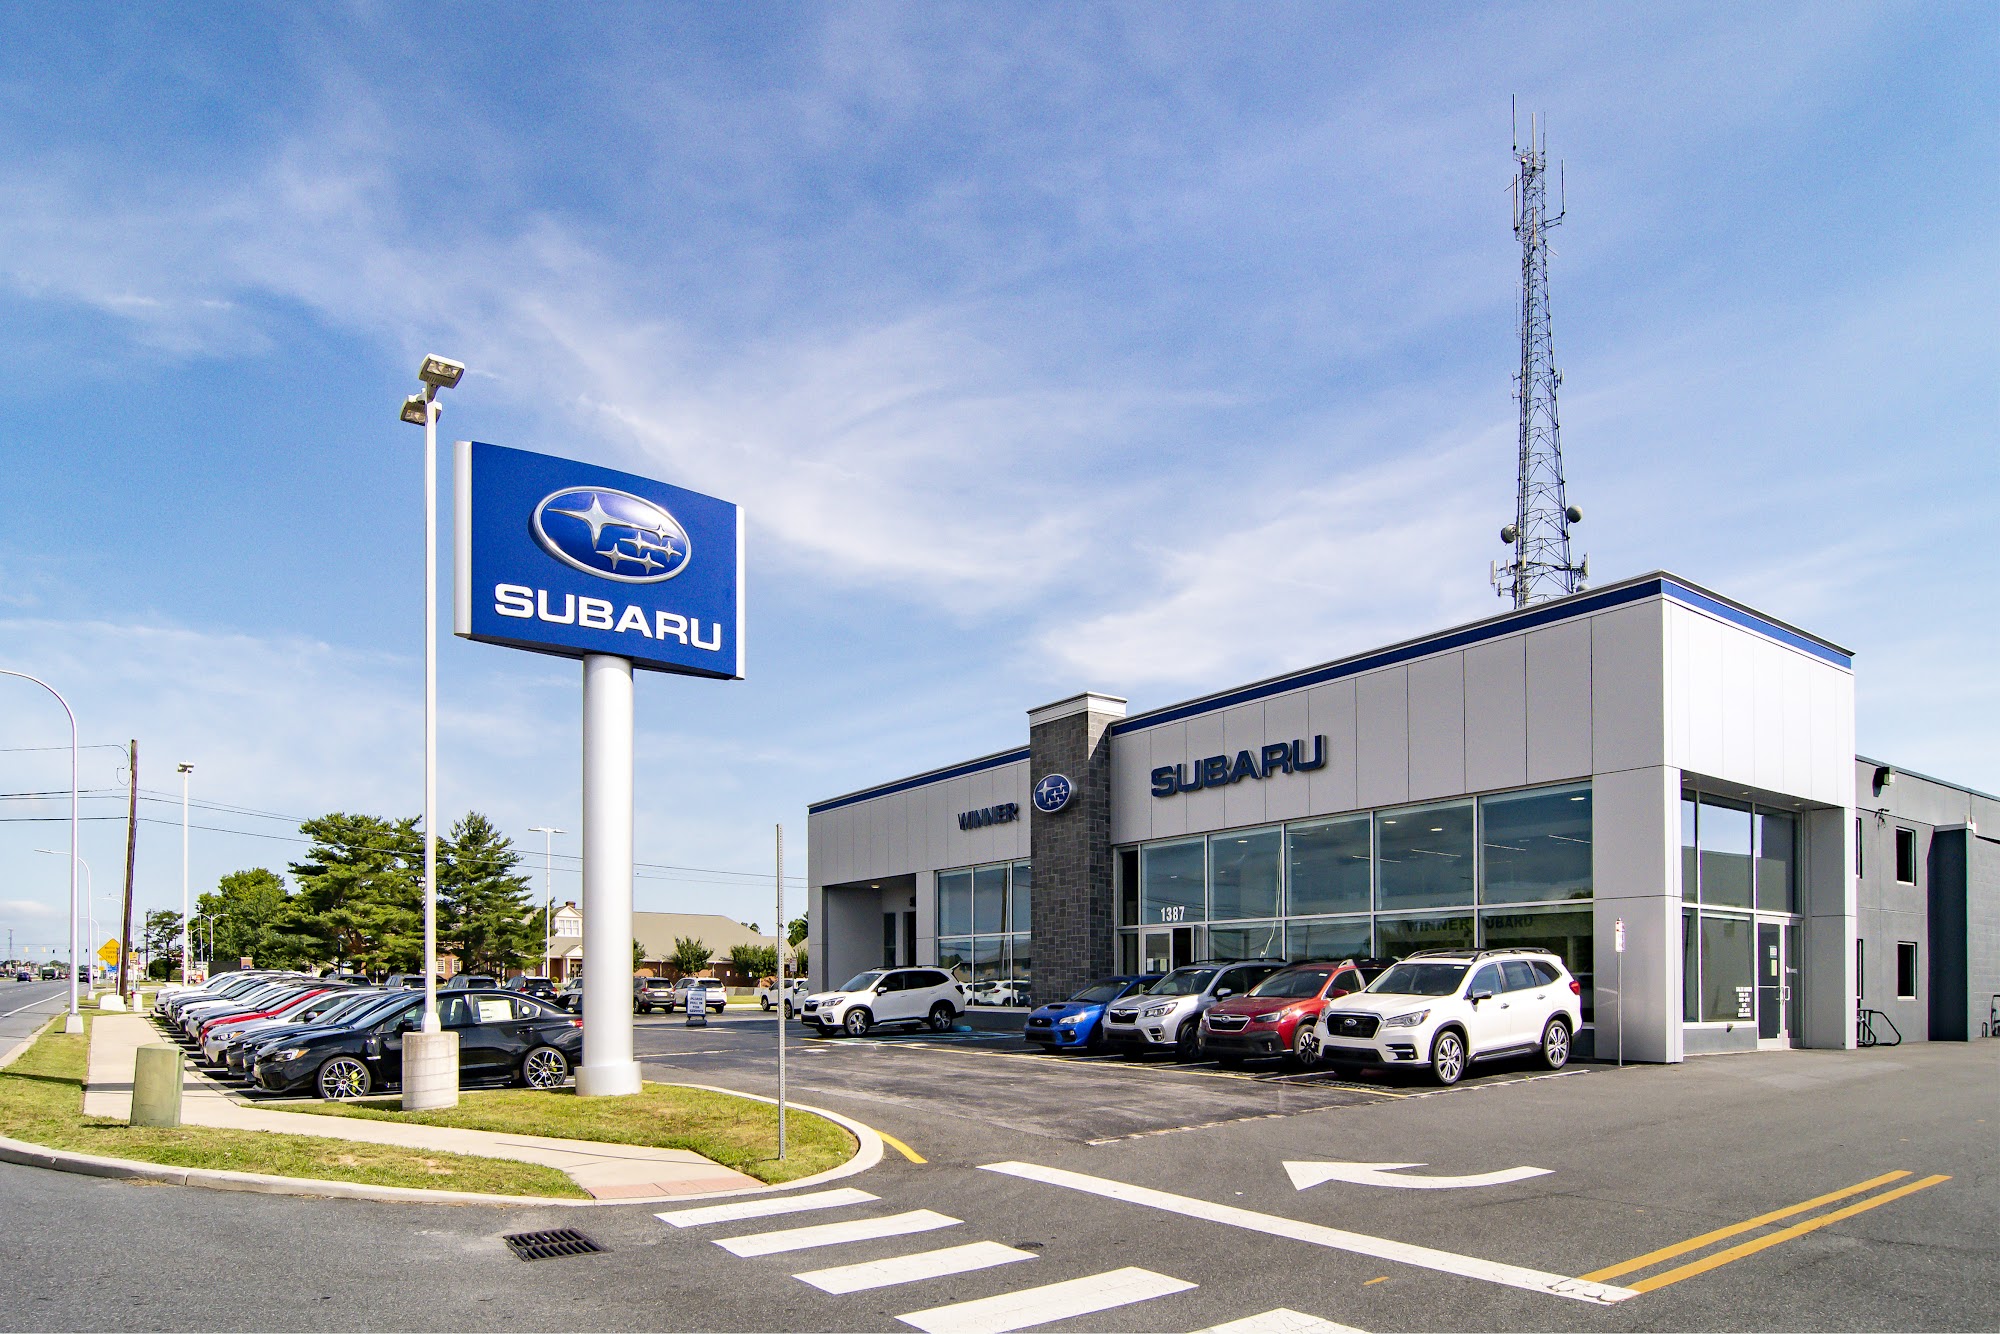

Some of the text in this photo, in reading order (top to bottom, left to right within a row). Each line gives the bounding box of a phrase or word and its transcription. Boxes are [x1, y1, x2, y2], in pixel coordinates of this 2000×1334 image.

[495, 583, 721, 652] SUBARU
[1151, 734, 1327, 798] SUBARU
[957, 802, 1019, 831] WINNER
[1160, 906, 1185, 922] 1387
